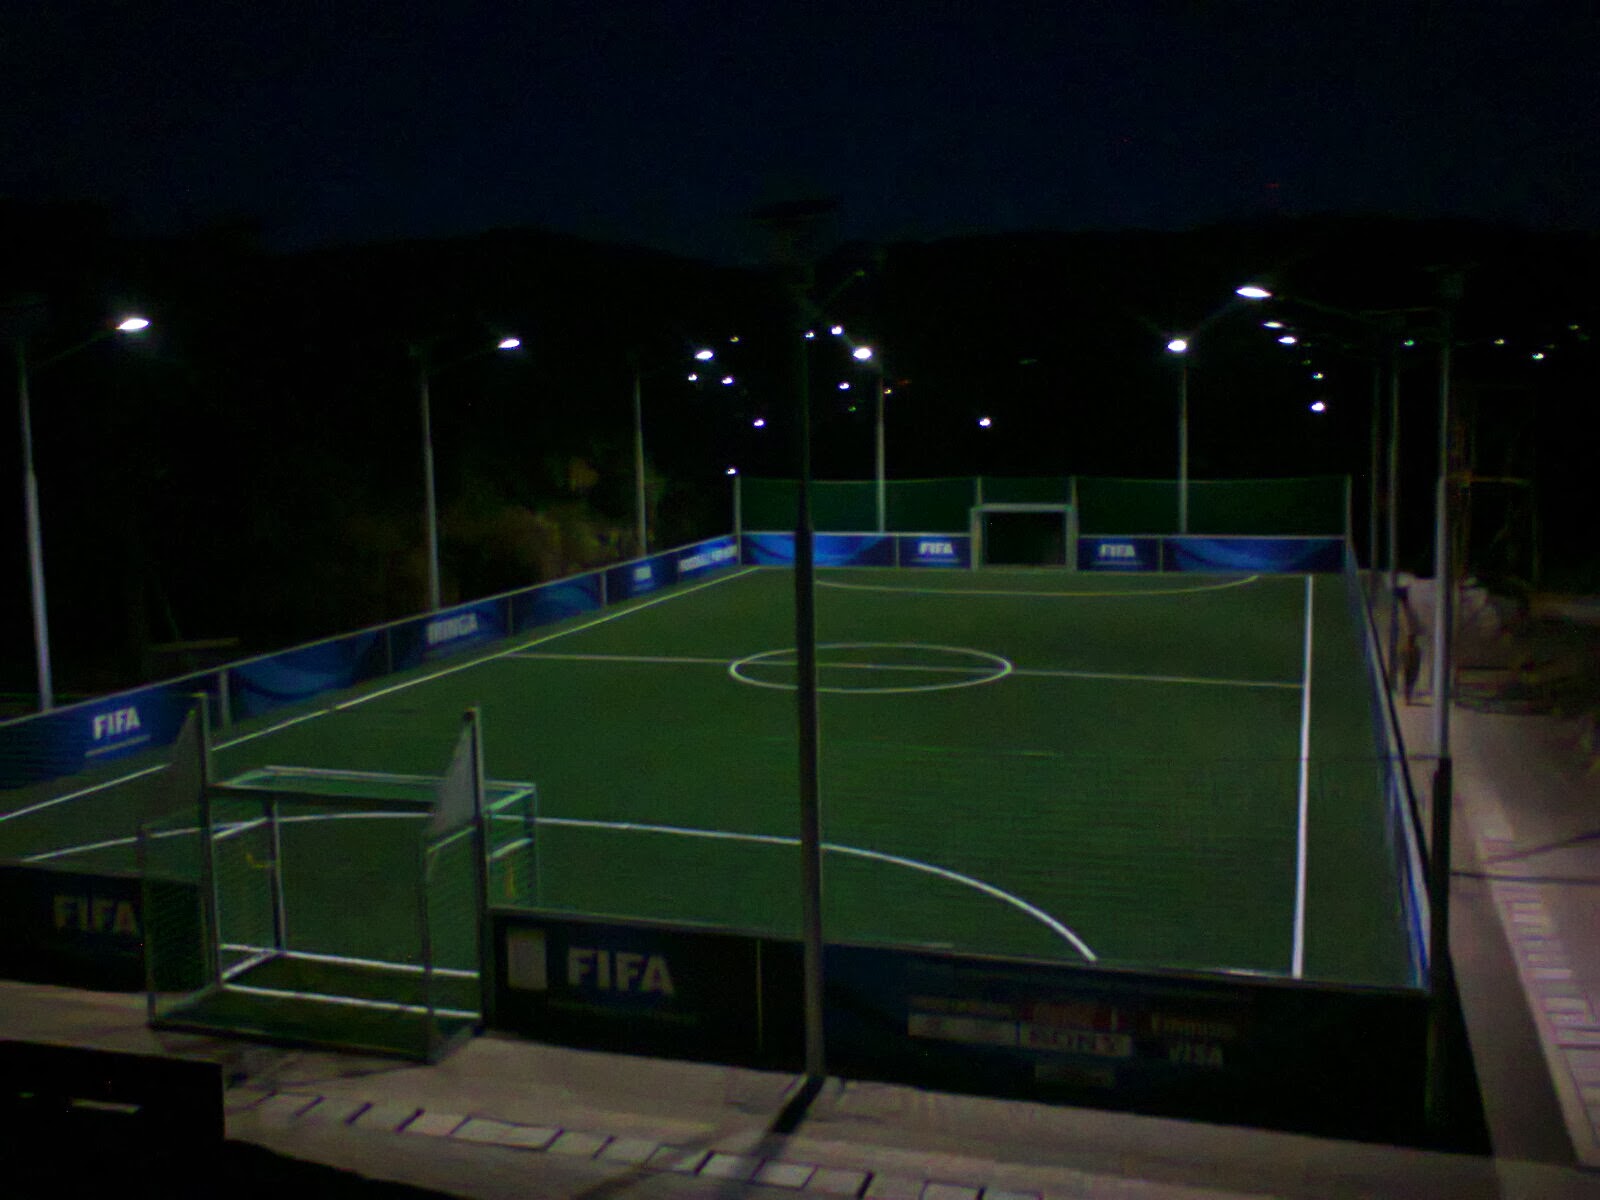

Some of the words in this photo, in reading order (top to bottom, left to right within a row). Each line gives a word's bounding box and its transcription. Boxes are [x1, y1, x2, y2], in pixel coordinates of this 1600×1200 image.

[919, 541, 953, 555] FIFA
[92, 706, 141, 740] FIFA
[52, 894, 138, 935] FIFA
[566, 946, 674, 995] FIFA
